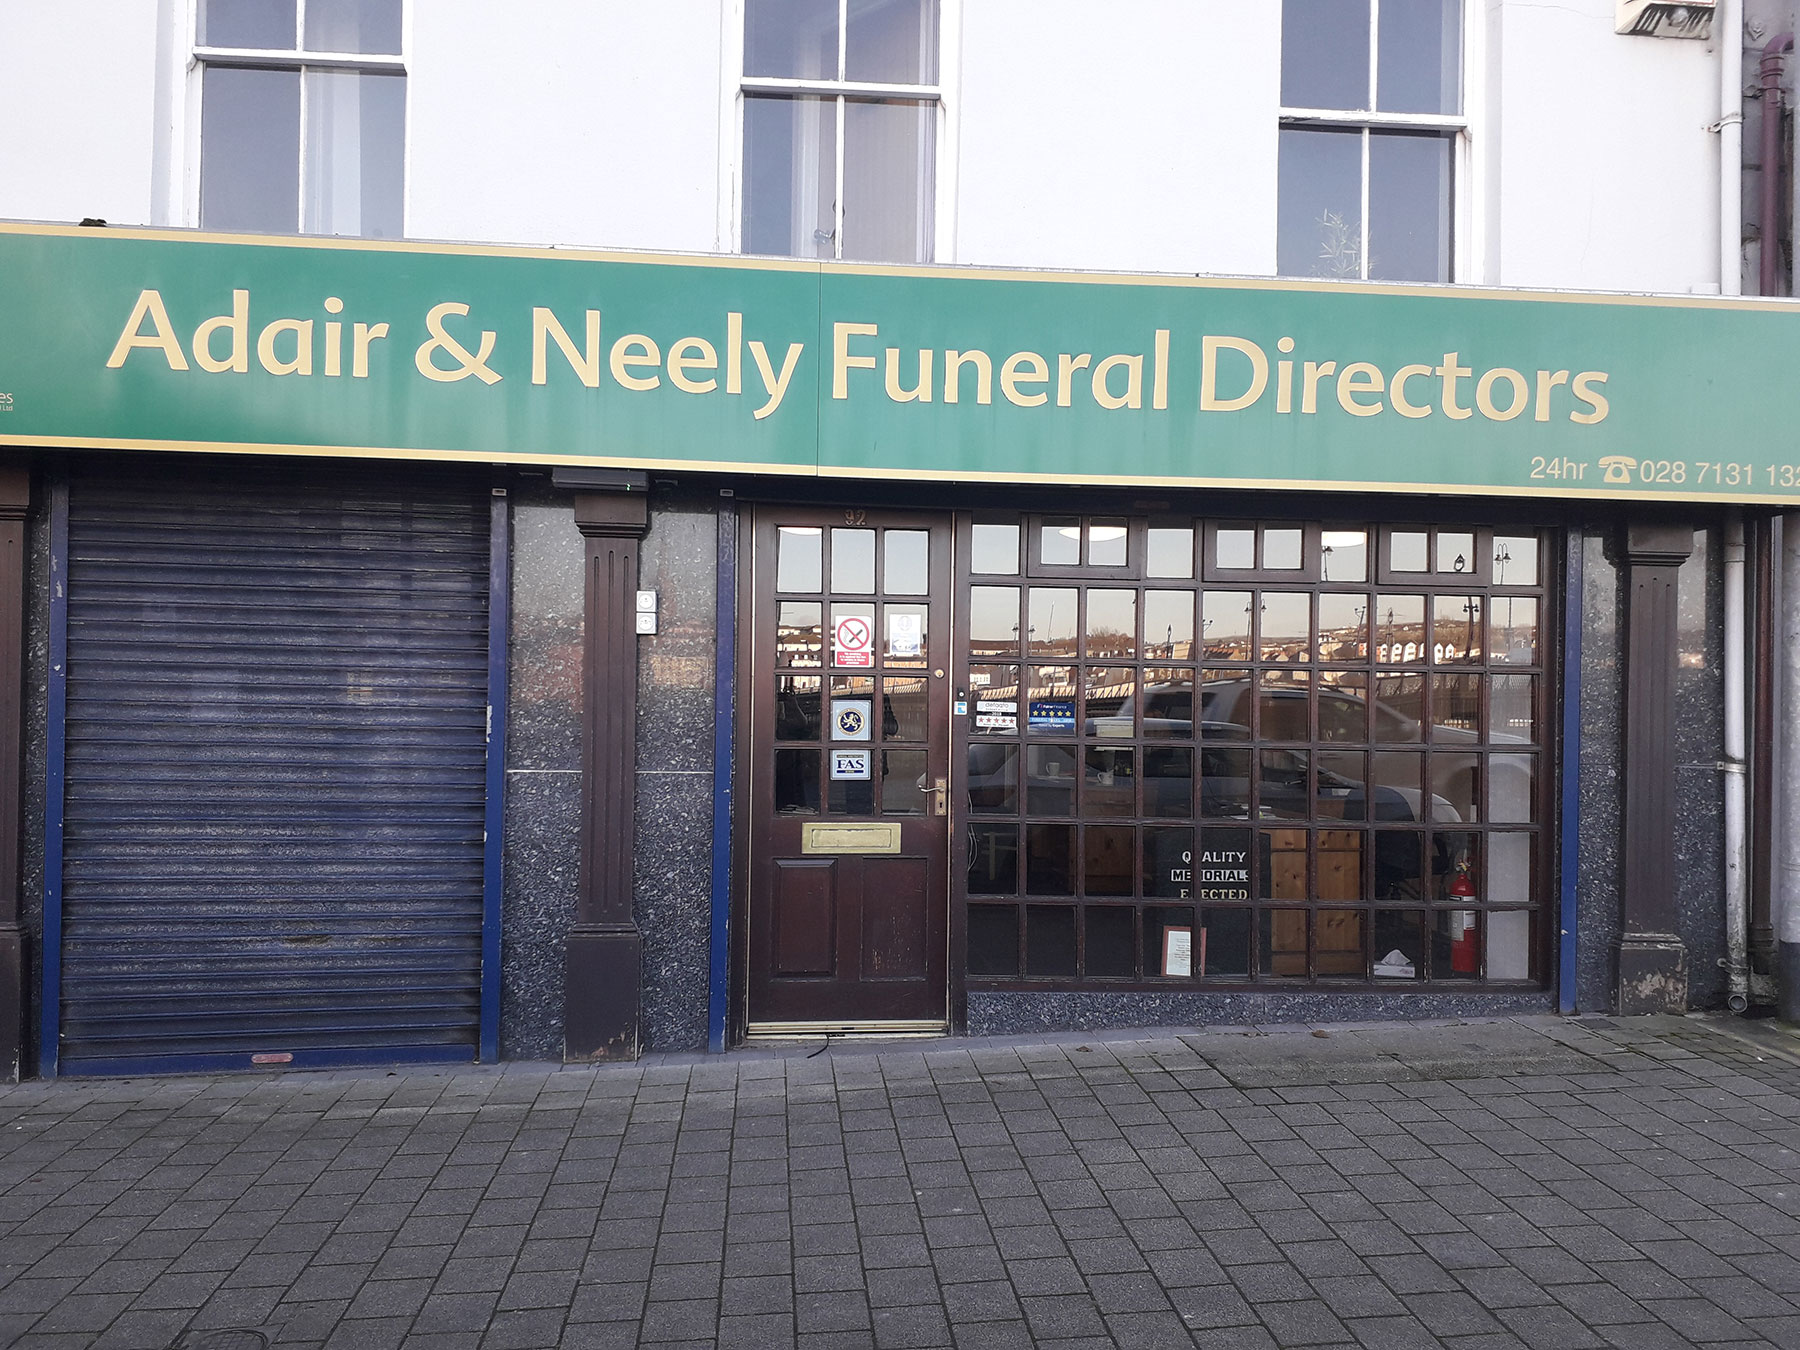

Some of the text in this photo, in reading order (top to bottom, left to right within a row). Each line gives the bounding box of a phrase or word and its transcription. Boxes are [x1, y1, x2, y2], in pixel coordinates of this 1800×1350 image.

[106, 288, 1609, 425] Adair & Neely Funeral Directors
[1529, 455, 1588, 481] 24hr
[1639, 459, 1687, 484] 028
[1695, 462, 1753, 486] 7131
[837, 759, 865, 769] FAS
[1182, 851, 1246, 864] QALITY
[1173, 869, 1248, 881] MEORIAL
[1180, 888, 1248, 900] EECTED
